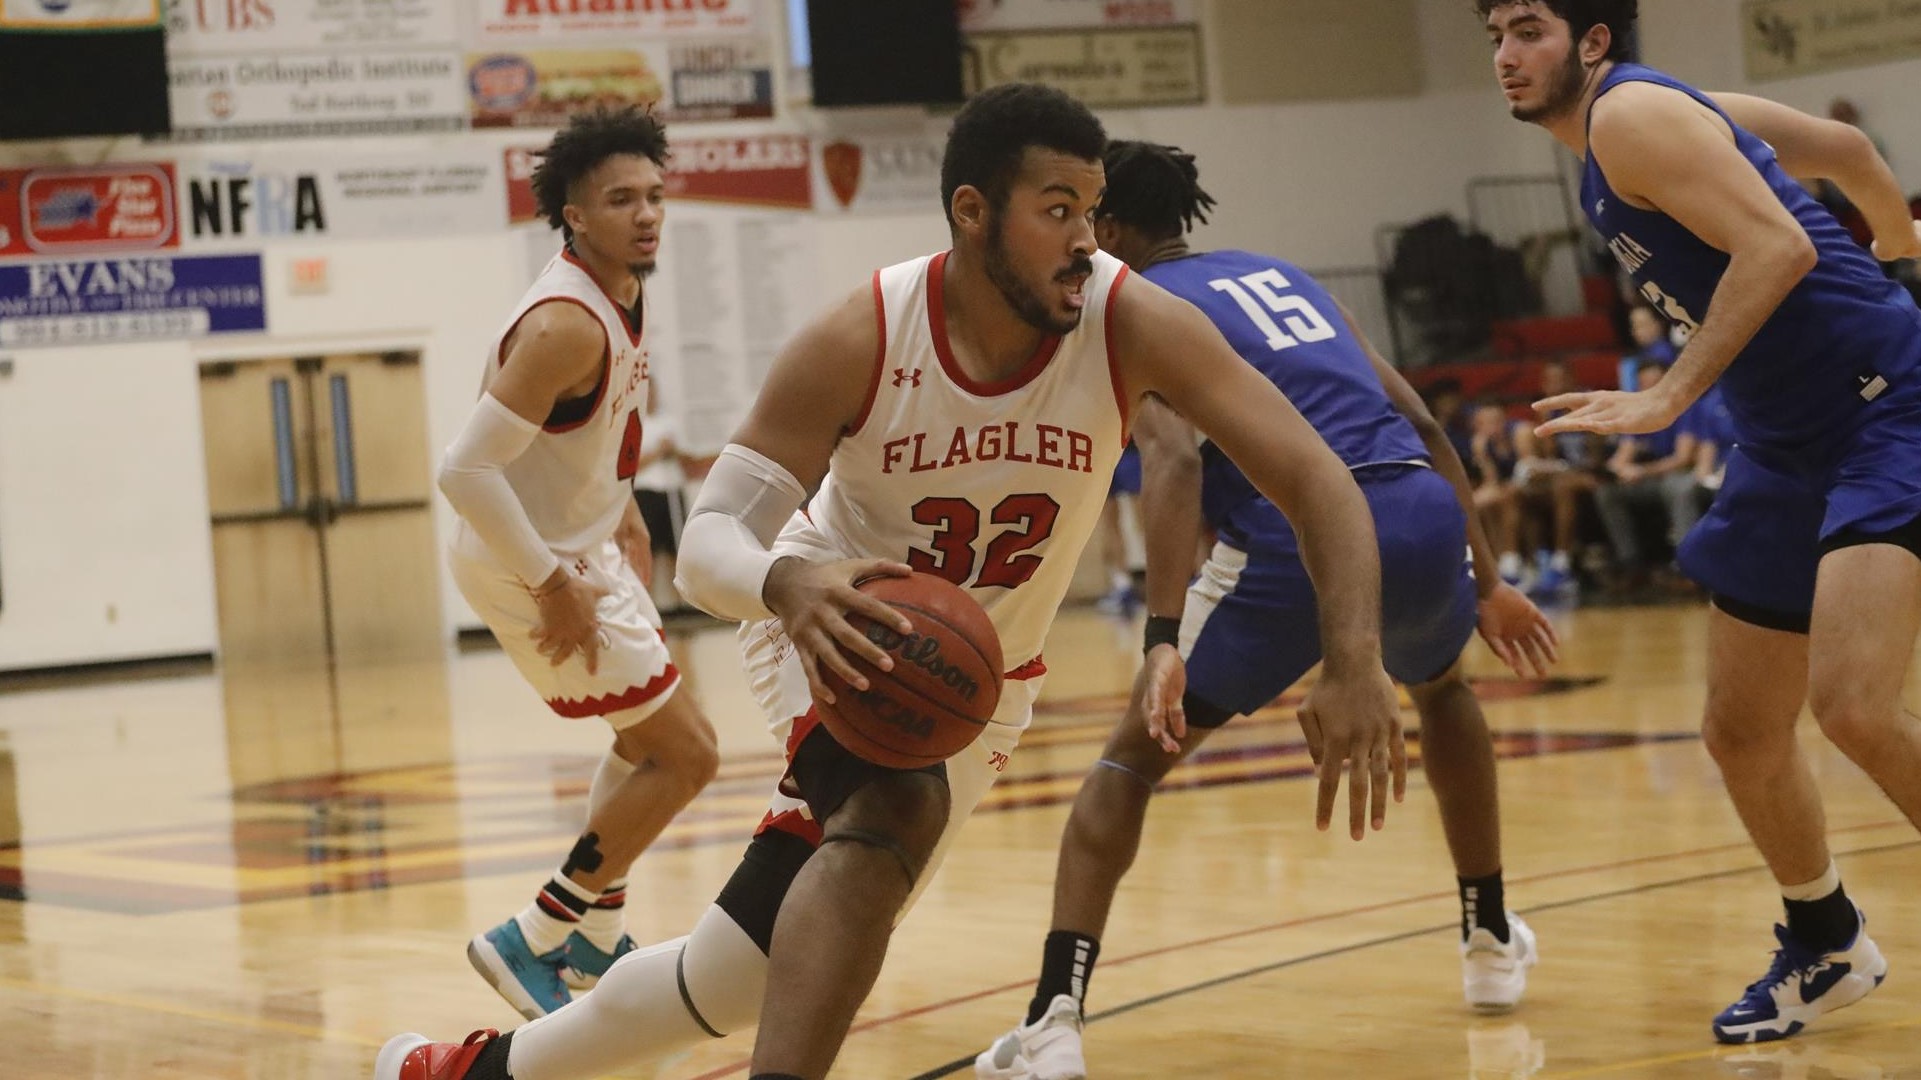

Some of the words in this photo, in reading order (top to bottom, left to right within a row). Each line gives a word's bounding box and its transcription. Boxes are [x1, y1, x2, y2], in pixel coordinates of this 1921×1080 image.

[190, 175, 326, 235] NFRA
[29, 259, 175, 297] EVANS
[1208, 268, 1336, 351] 15
[1639, 281, 1701, 341] 3
[881, 421, 1093, 474] FLAGLER
[906, 493, 1061, 590] 32
[866, 622, 978, 704] Wilson
